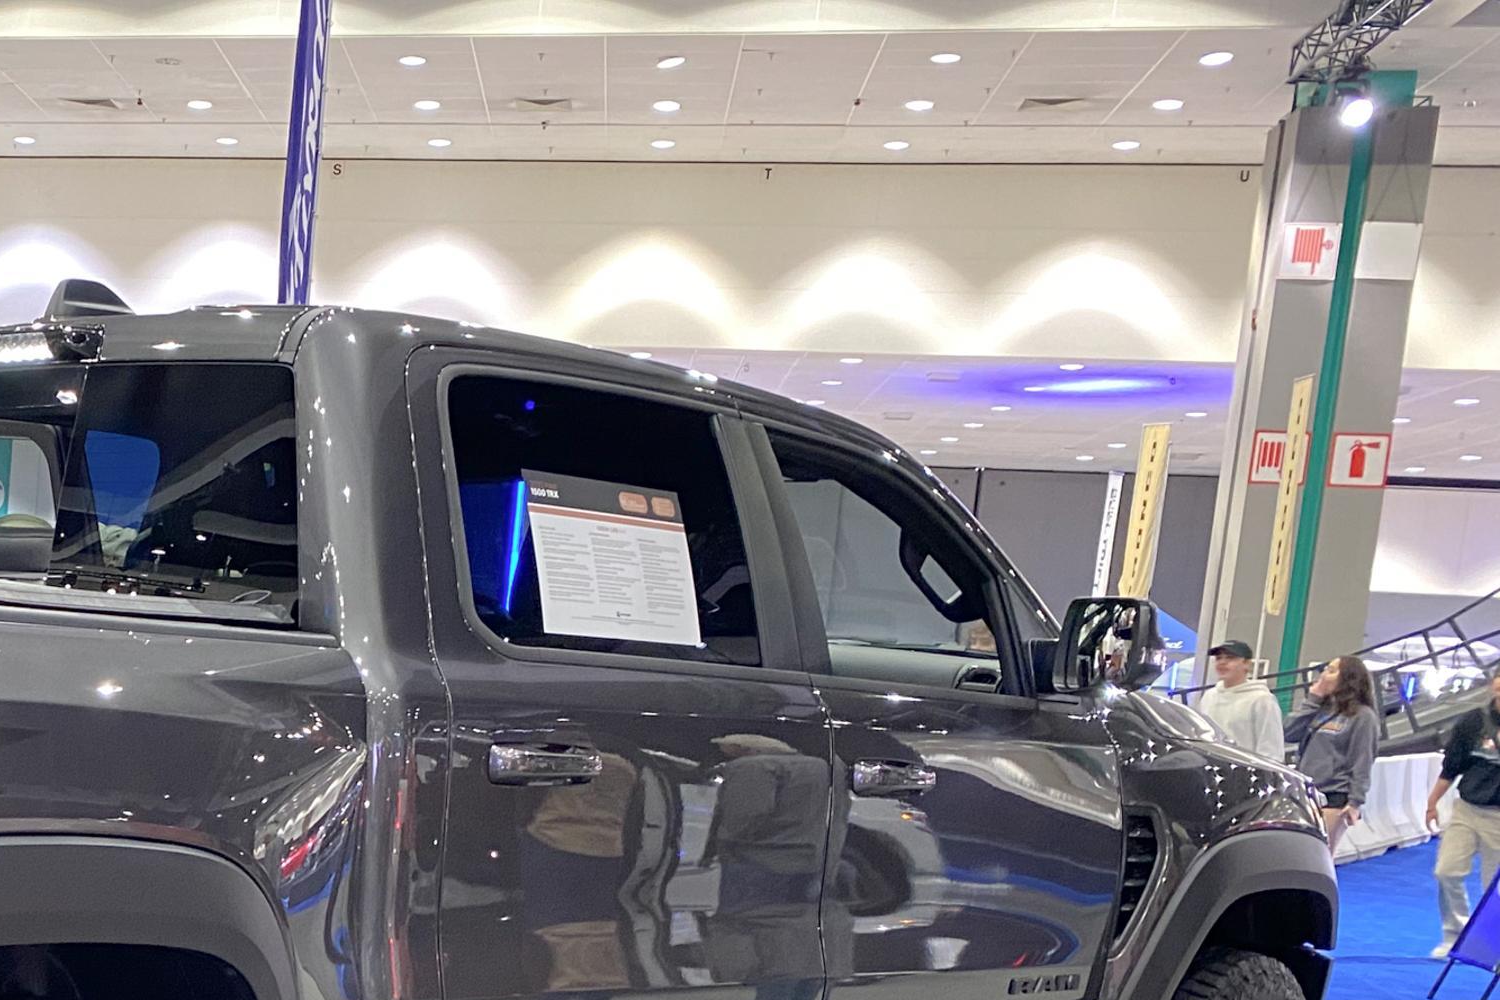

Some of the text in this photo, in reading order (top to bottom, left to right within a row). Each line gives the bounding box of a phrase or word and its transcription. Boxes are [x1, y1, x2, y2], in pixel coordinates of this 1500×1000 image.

[332, 163, 342, 175] S
[765, 168, 773, 179] T
[1240, 170, 1250, 182] U
[1008, 974, 1081, 995] RAM
